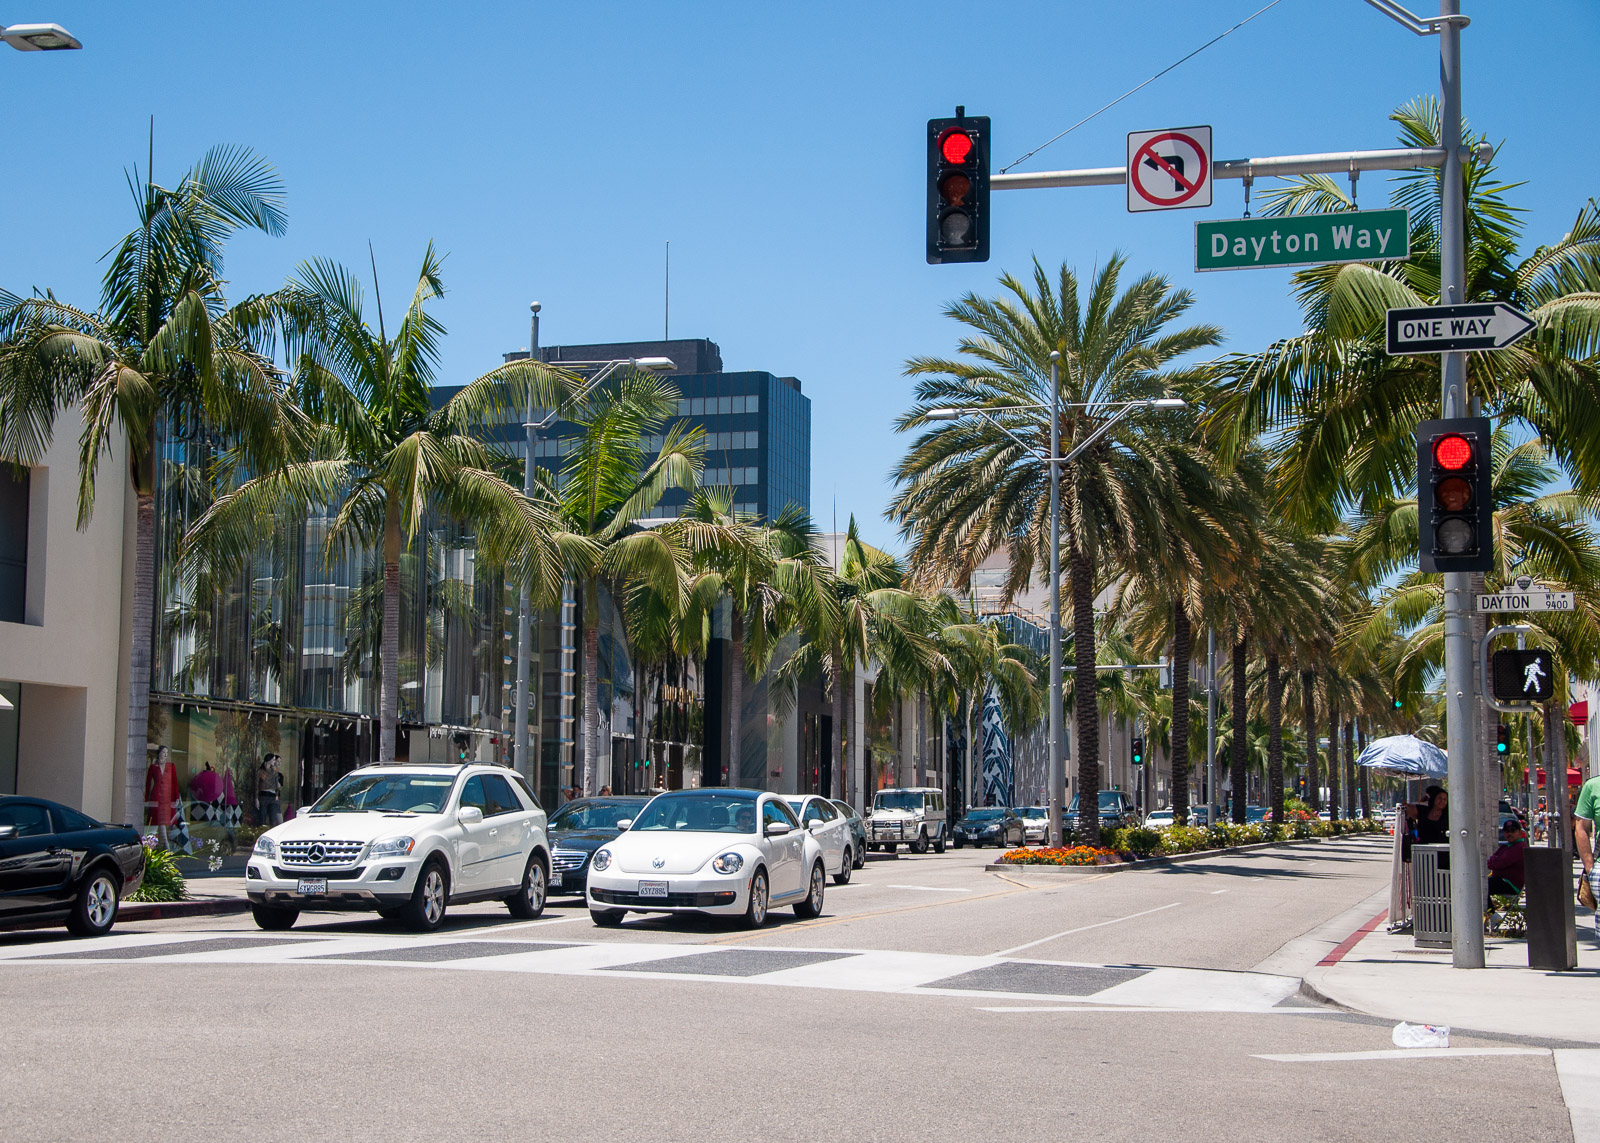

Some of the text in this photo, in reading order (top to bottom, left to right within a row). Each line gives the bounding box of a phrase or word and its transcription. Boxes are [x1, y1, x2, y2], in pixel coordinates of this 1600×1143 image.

[1211, 225, 1392, 261] Dayton Way
[1403, 318, 1491, 339] ONE WAY
[1481, 595, 1530, 609] DAYTON
[1545, 600, 1568, 609] 9400
